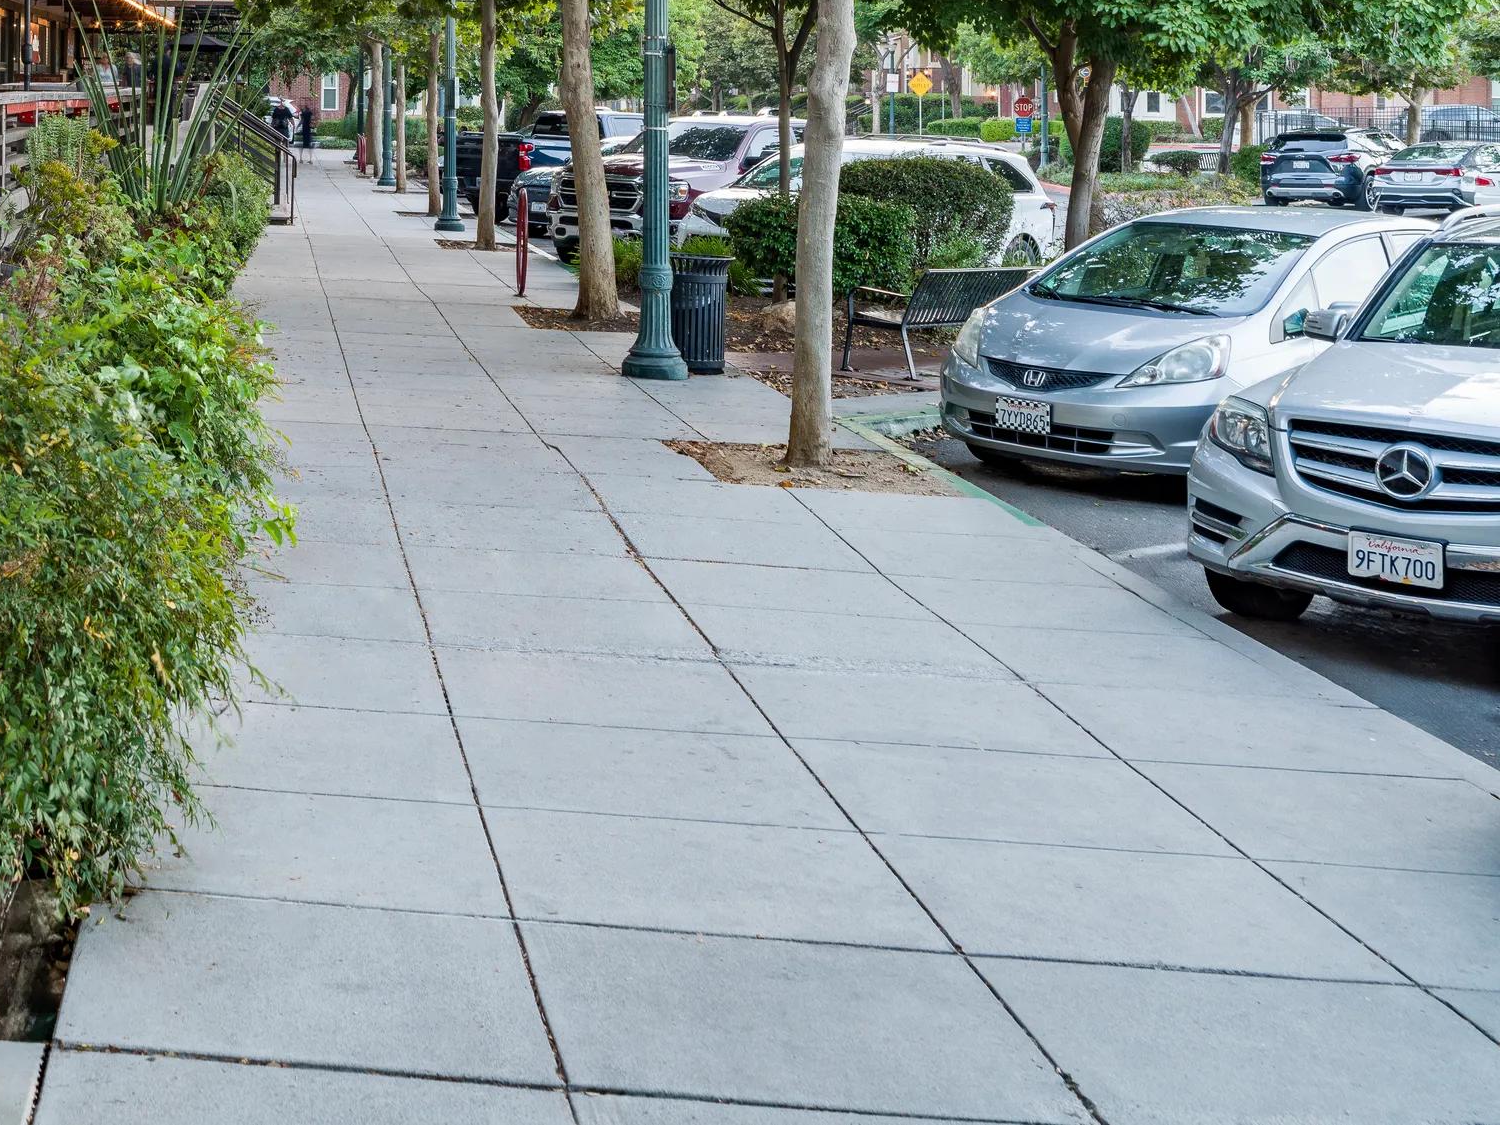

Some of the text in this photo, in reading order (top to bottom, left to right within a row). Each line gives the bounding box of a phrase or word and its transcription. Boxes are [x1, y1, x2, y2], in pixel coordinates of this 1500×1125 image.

[1014, 103, 1033, 112] STOP
[999, 408, 1046, 428] 7YYD865
[1368, 540, 1422, 556] California
[1355, 549, 1436, 581] 9FTK700
